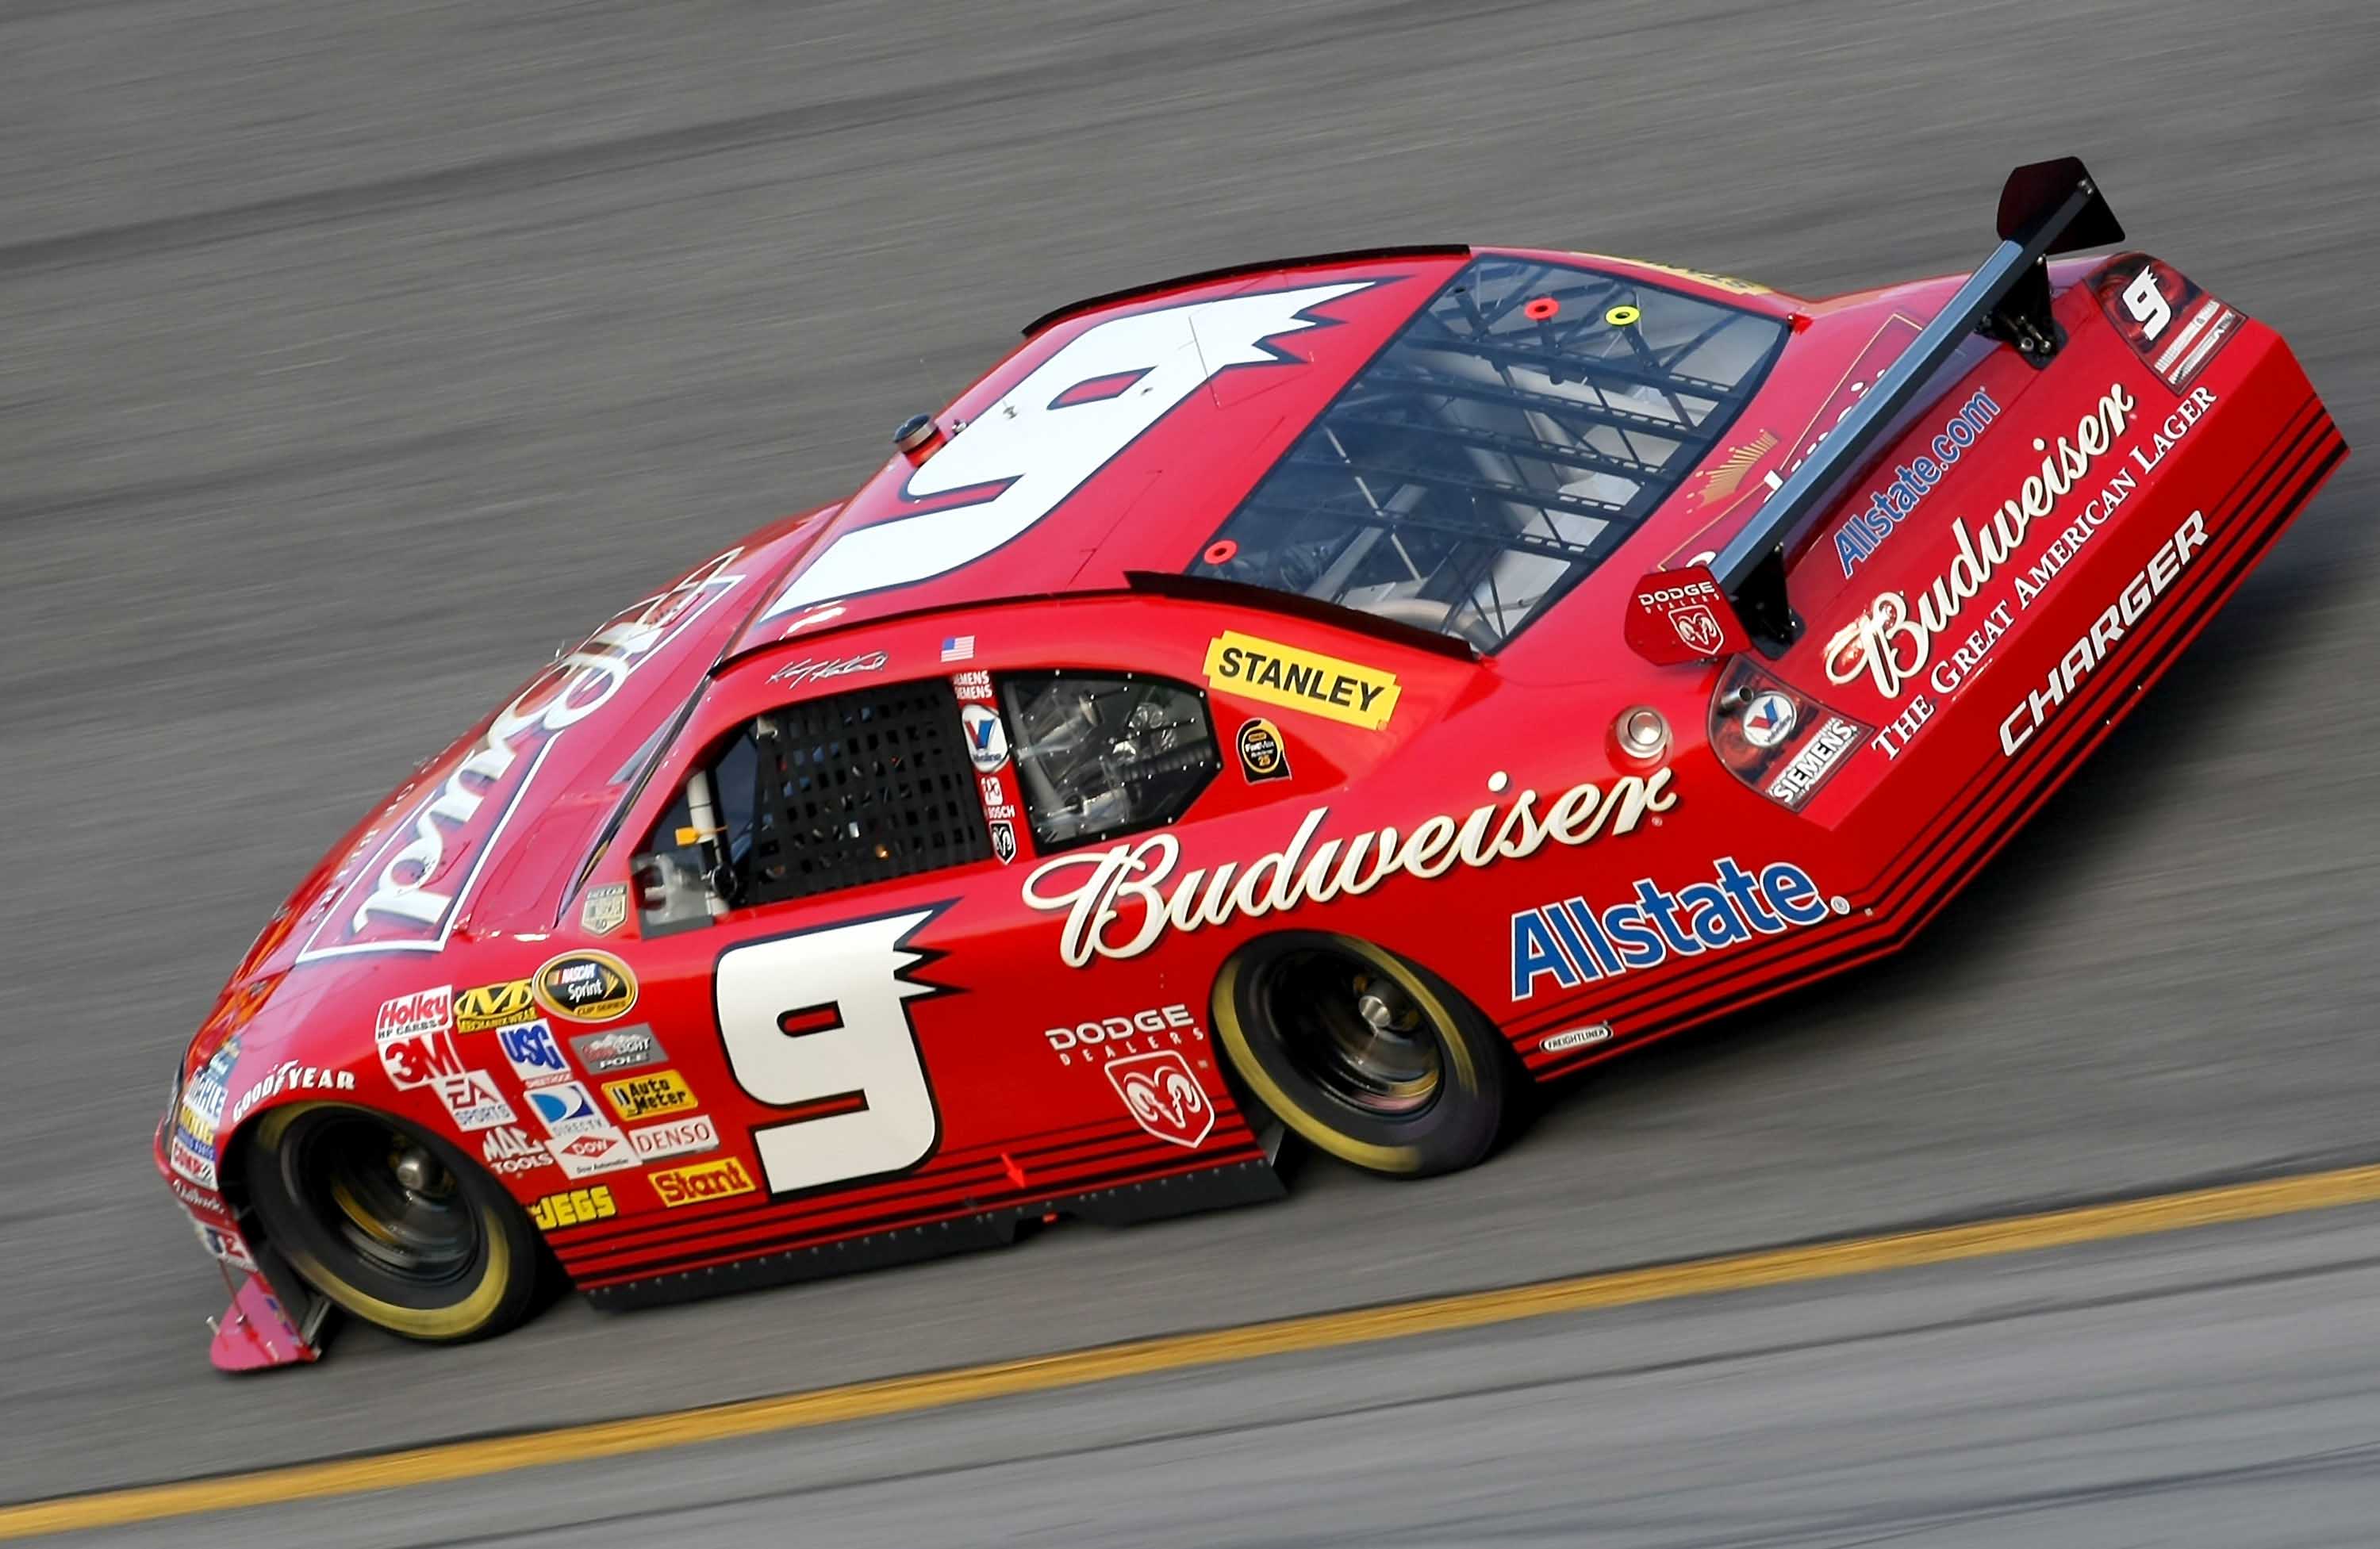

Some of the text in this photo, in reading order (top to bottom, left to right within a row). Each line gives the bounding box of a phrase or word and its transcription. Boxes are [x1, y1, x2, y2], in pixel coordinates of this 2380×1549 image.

[2123, 265, 2171, 341] 9
[758, 279, 1379, 625] 9
[1833, 389, 2002, 578] Allstate.com
[1825, 383, 2136, 699] Budweiser
[1638, 581, 1715, 607] DODGE
[1871, 694, 1936, 761] THE
[1930, 600, 2016, 695] GREAT
[2013, 468, 2139, 611] AMERICAN
[2130, 385, 2218, 476] LAGER
[1645, 592, 1721, 615] DEALERS
[1999, 510, 2211, 758] CHARGER
[1219, 647, 1385, 712] STANLEY
[1772, 719, 1854, 803] SIEMENS
[1022, 768, 1677, 968] Budweiser
[1511, 856, 1829, 1003] Allstate
[561, 963, 597, 984] NASCAR
[566, 979, 604, 1003] Sprint
[378, 994, 449, 1027] Holley
[1044, 1003, 1195, 1051] DODGE
[385, 1030, 466, 1083] 3M
[499, 1024, 566, 1071] USG
[713, 904, 946, 1196] 9
[1059, 1027, 1204, 1066] DEALERS
[232, 1063, 357, 1124] GOODYEAR
[445, 1078, 499, 1110] EA
[628, 1078, 670, 1097] Auto
[632, 1090, 688, 1115] Meter
[482, 1126, 546, 1161] MAC
[635, 1121, 710, 1152] DENSO
[491, 1152, 555, 1175] TOOLS
[654, 1161, 749, 1202] Stant
[529, 1186, 617, 1230] JEGS
